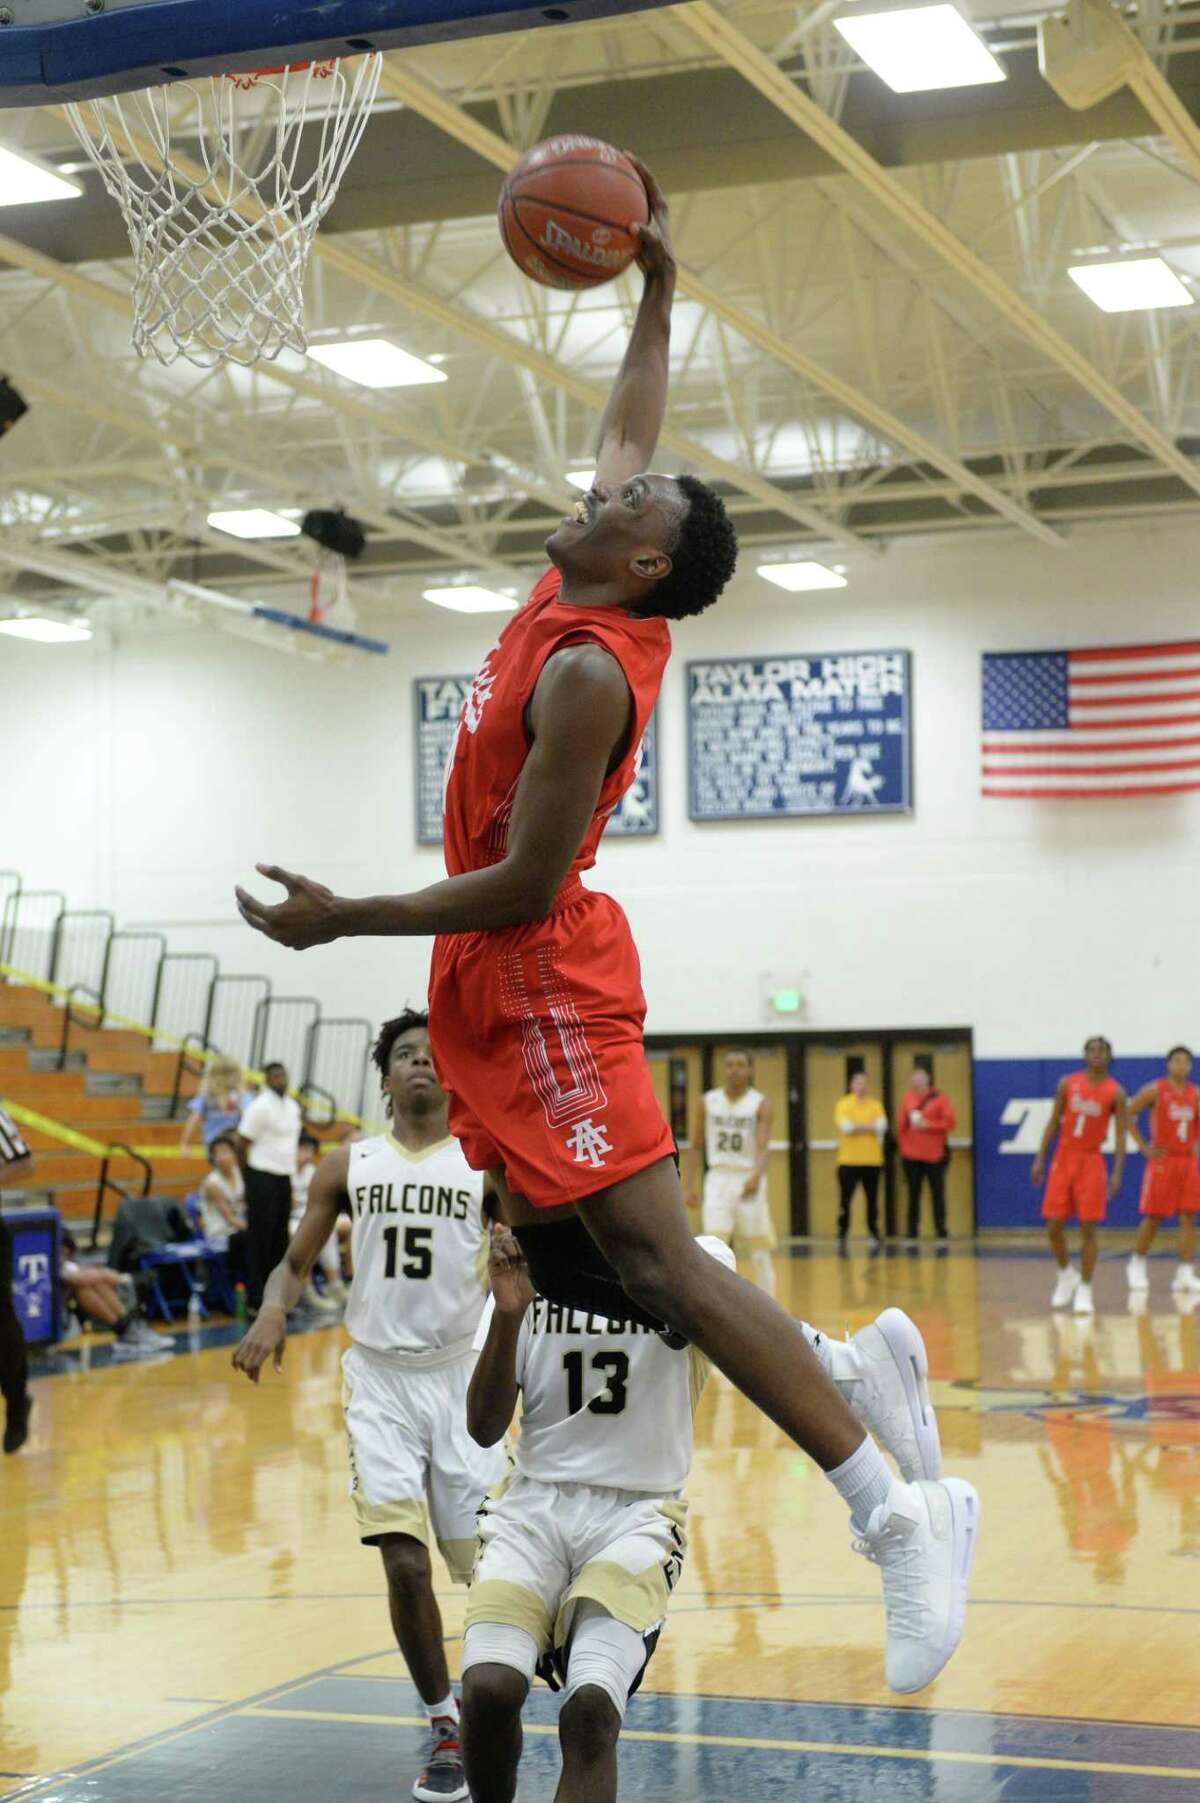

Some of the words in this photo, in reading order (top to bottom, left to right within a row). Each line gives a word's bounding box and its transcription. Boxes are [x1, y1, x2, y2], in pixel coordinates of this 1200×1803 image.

[718, 1132, 743, 1153] 20
[356, 1184, 470, 1220] FALCONS
[384, 1226, 433, 1279] 15
[563, 1351, 629, 1415] 13
